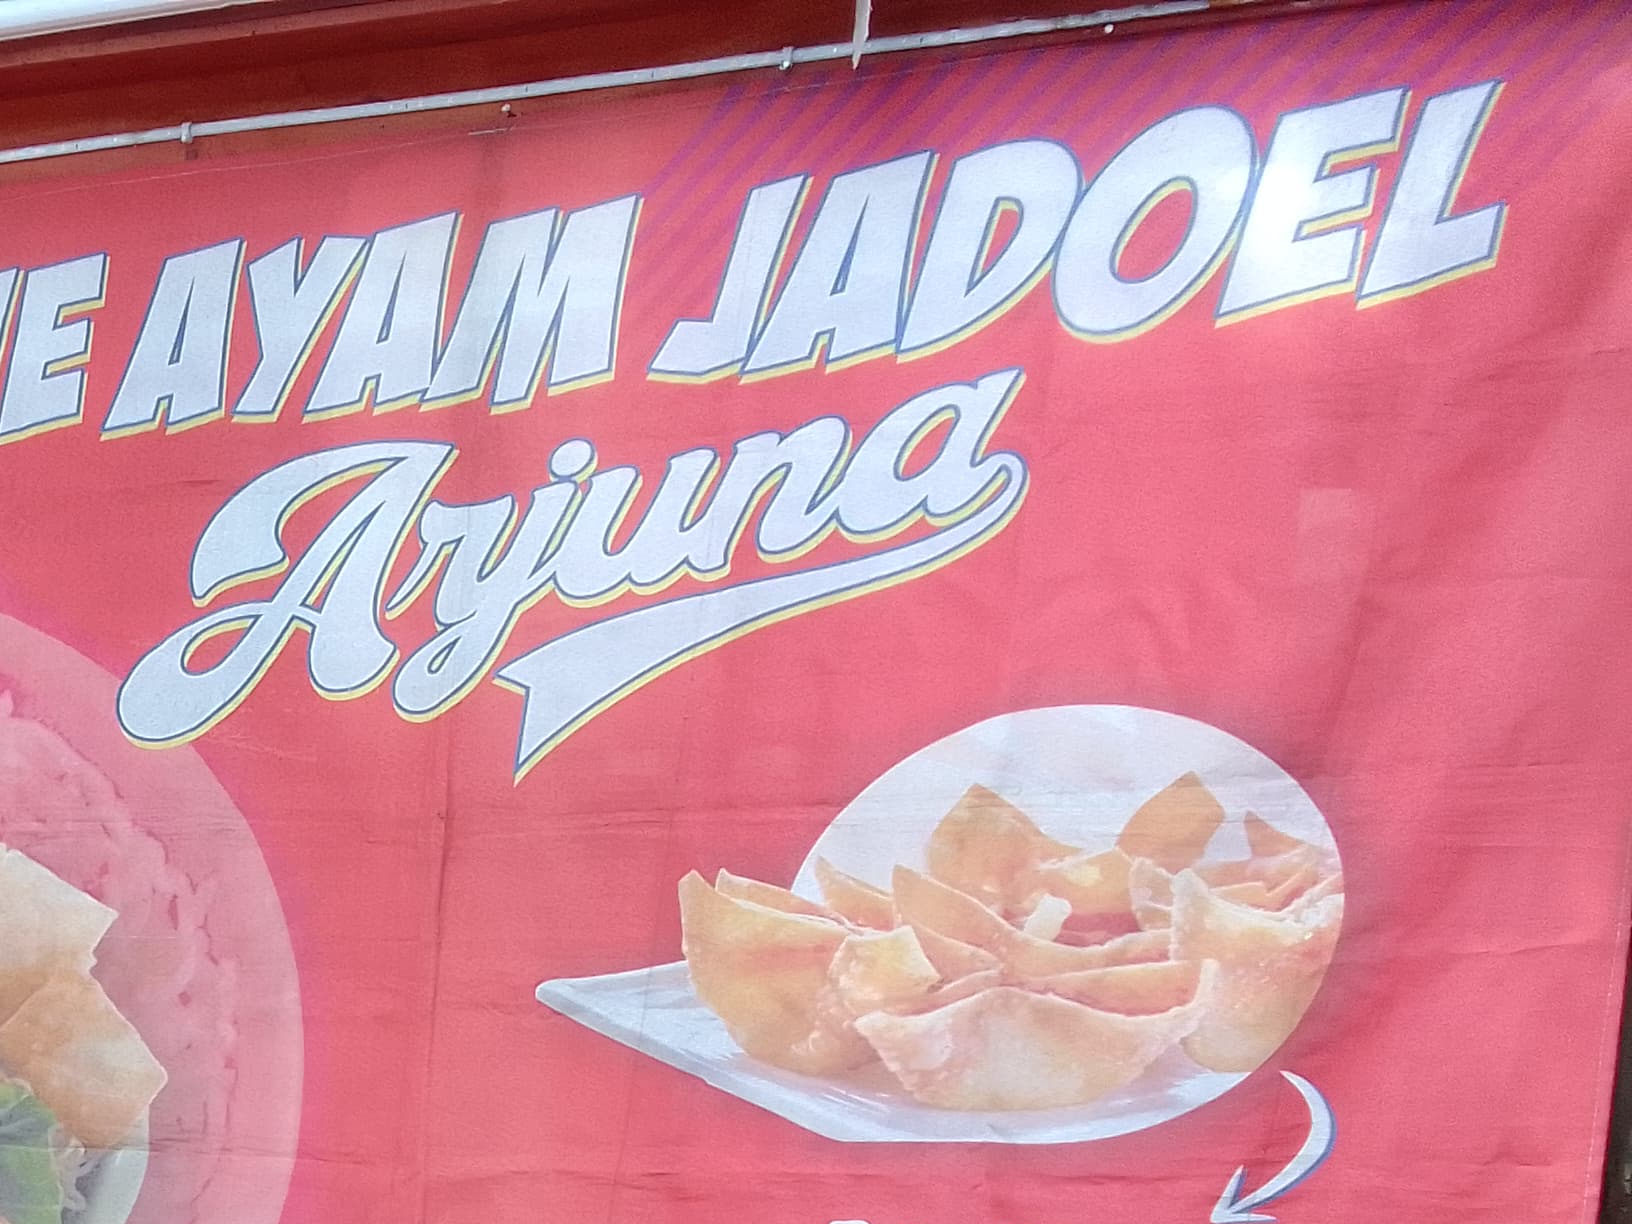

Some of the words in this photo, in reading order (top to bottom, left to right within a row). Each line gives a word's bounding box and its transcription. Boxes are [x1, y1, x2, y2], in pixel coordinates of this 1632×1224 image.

[100, 193, 643, 440] AYAM
[646, 80, 1506, 384] JADOEL
[116, 367, 1027, 752] Arjuna
